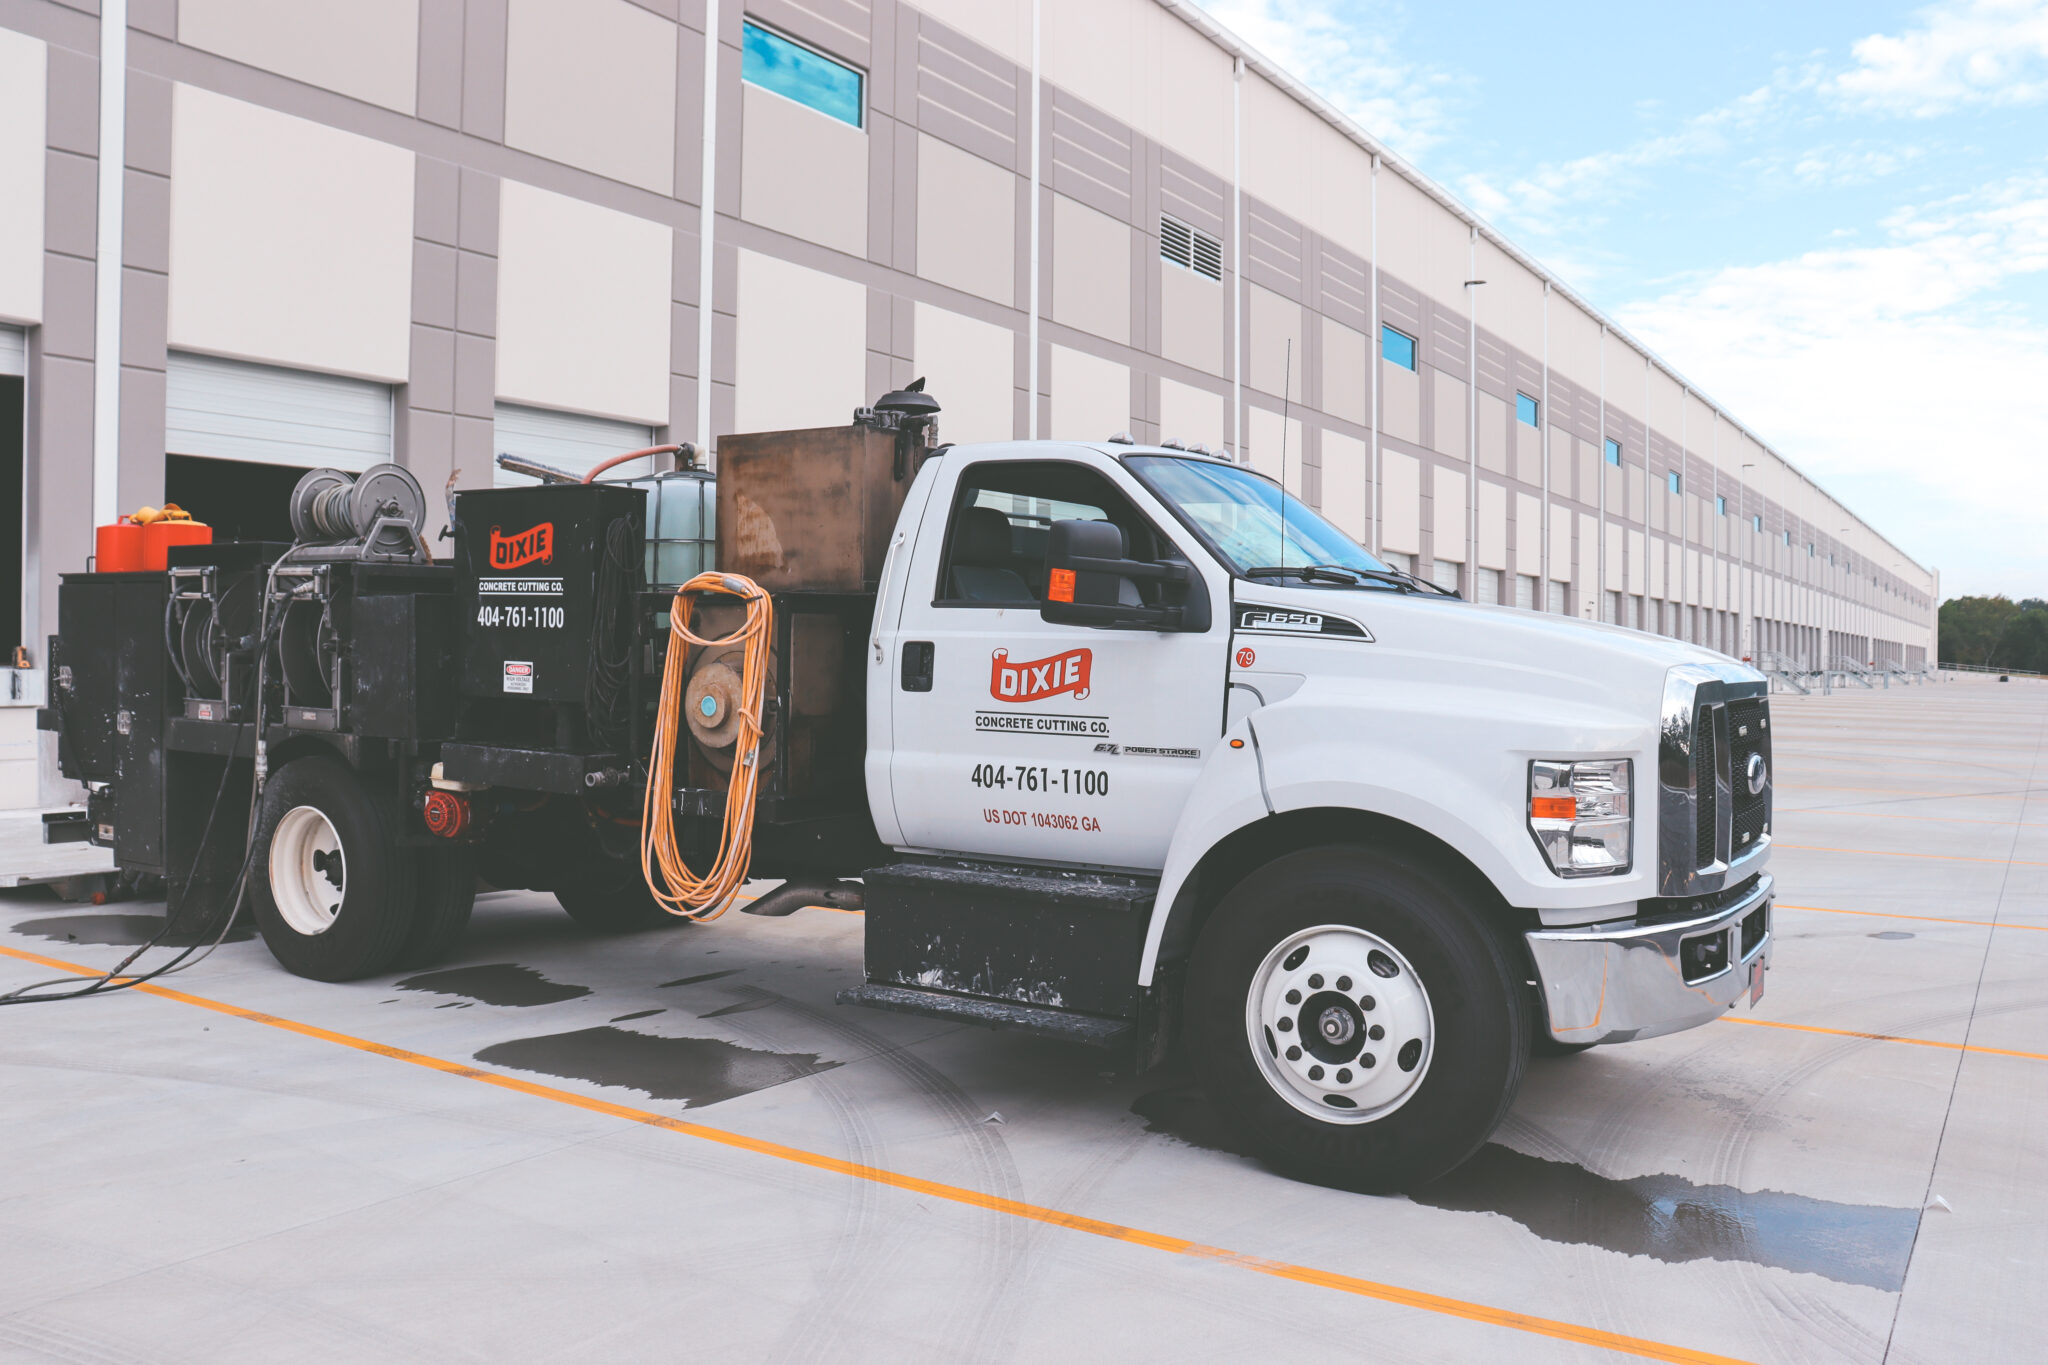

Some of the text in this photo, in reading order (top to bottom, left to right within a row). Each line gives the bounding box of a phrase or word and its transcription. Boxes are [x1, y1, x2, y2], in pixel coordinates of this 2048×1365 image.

[495, 528, 547, 565] DIXIE
[479, 581, 564, 592] CONCRETE CUTTING CO.
[477, 606, 564, 629] 404-761-1100
[1238, 651, 1254, 665] 79
[508, 665, 530, 674] DANGER
[999, 654, 1083, 697] DIXIE
[975, 716, 1110, 734] CONCRETE CUTTING CO.
[1125, 746, 1158, 754] POWER
[1159, 748, 1197, 756] STROKE
[971, 763, 1109, 797] 404-761-1100
[983, 808, 1102, 833] US DOT 1043062 GA
